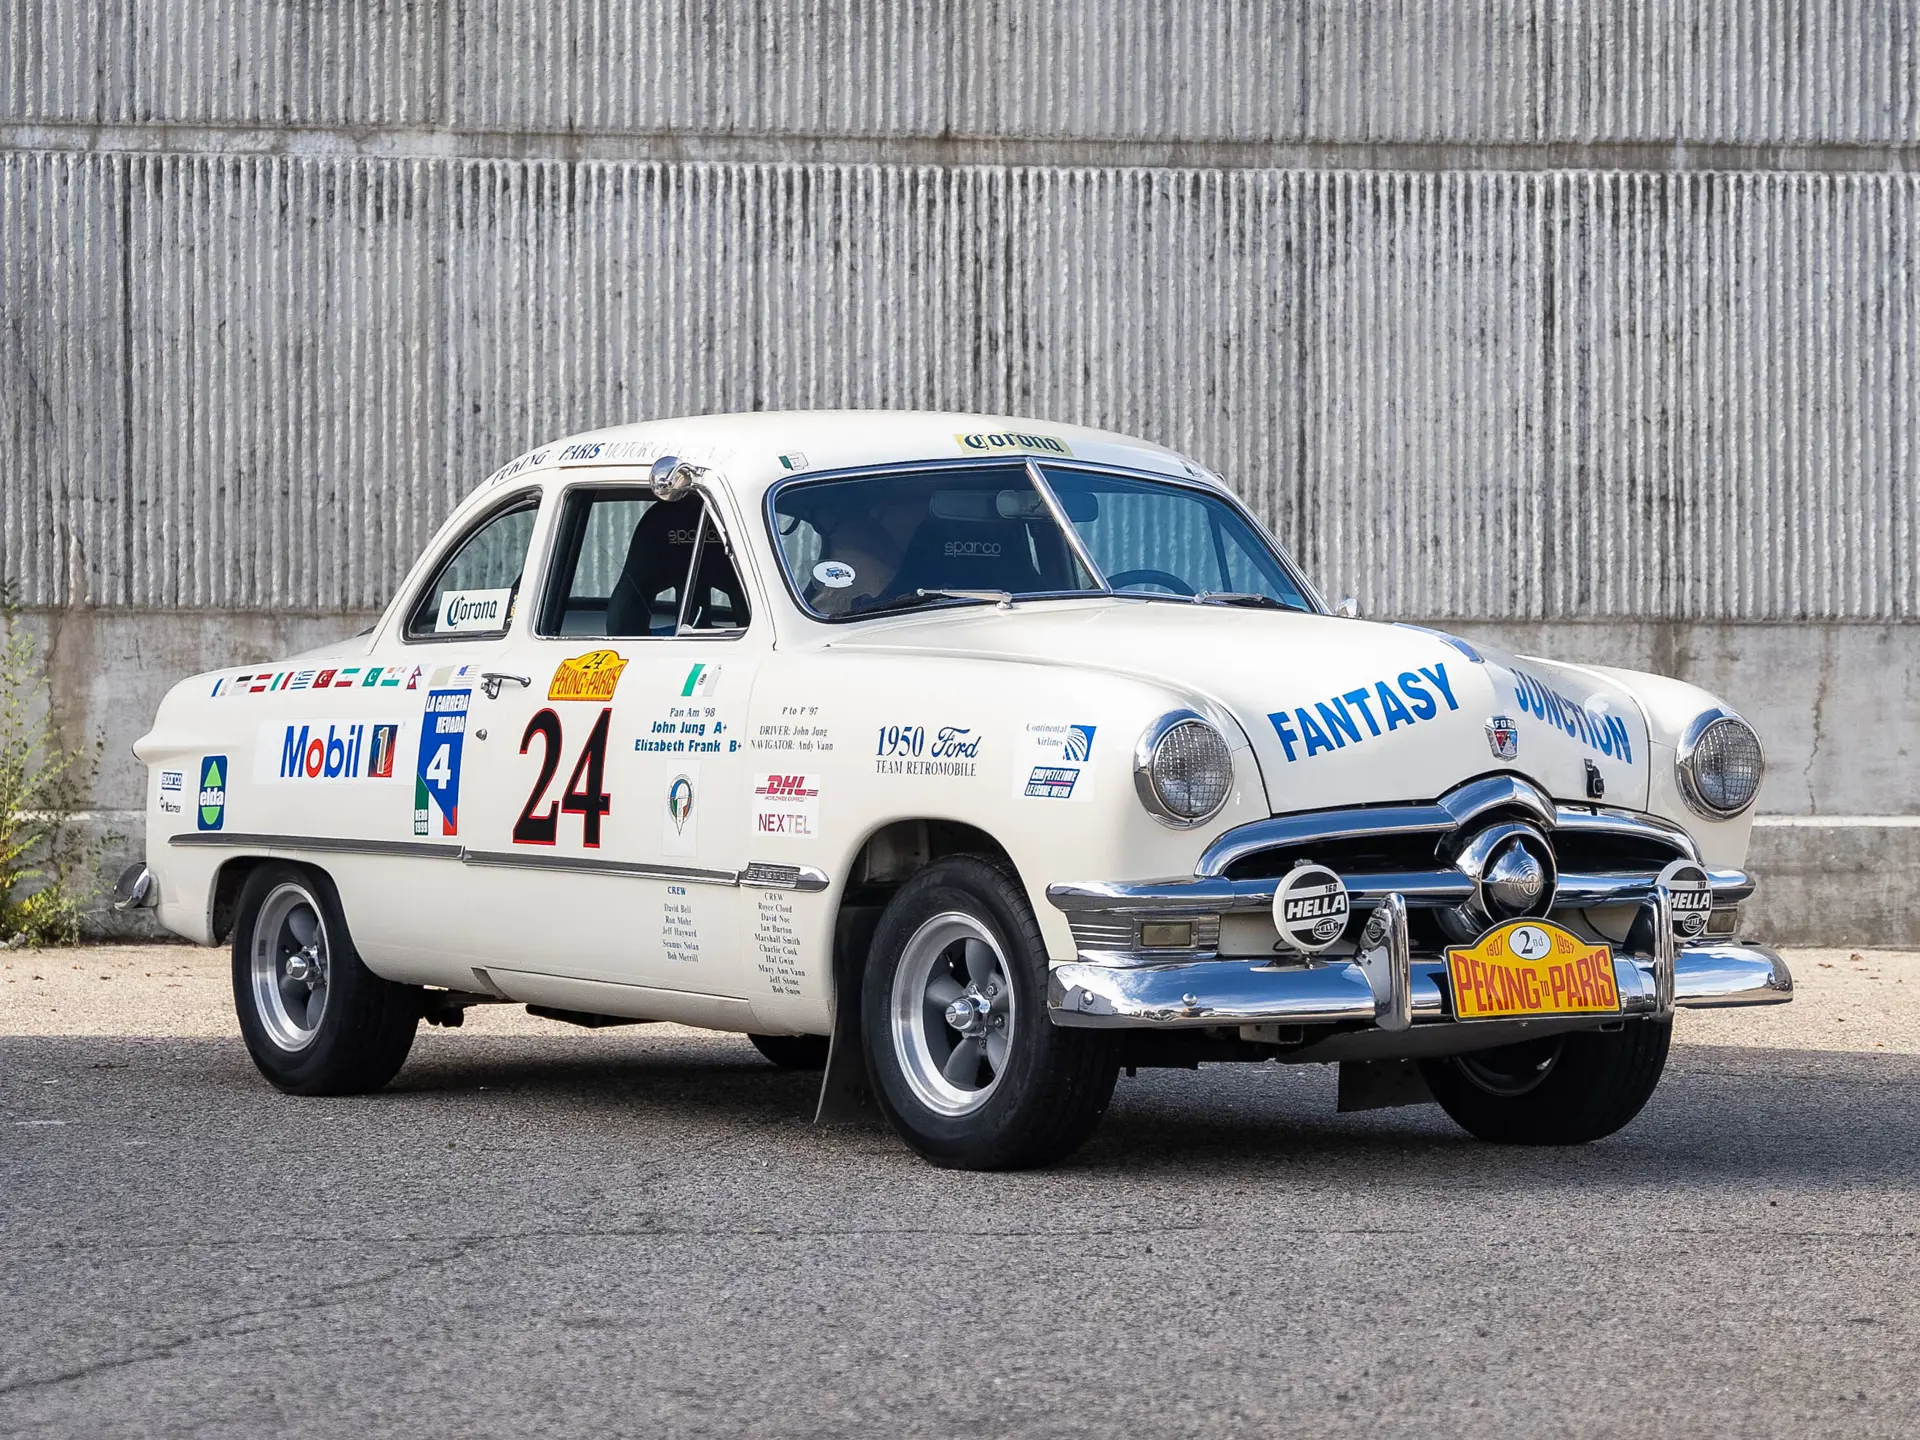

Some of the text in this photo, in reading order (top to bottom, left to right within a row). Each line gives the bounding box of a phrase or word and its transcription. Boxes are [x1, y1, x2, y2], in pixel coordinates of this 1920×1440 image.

[963, 432, 1065, 453] Corona
[558, 442, 606, 461] PARIS
[944, 540, 1001, 557] sparco
[446, 595, 498, 630] Corona
[581, 653, 610, 669] 24
[551, 663, 624, 694] PEKING PARIS
[425, 694, 469, 712] LA CARRERA
[782, 706, 788, 715] P
[789, 706, 797, 715] to
[800, 706, 806, 715] P
[669, 707, 684, 718] Pan
[686, 707, 700, 718] Am
[1267, 662, 1459, 763] FANTASY
[1509, 667, 1633, 765] JUNCTION
[435, 716, 466, 733] NEVADA
[651, 721, 727, 736] John Jung A+
[759, 725, 828, 737] DRIVER: John Jung
[1026, 723, 1068, 733] Continental
[634, 739, 742, 752] Elizabeth Frank B+
[751, 739, 795, 750] NAVIGATOR:
[799, 740, 813, 752] Andy
[876, 725, 982, 758] 1950 Ford
[1036, 737, 1063, 747] Airlines
[280, 724, 390, 778] Mobil 1
[426, 743, 452, 789] 4
[876, 760, 977, 776] TEAM RETROMOBILE
[512, 707, 613, 849] 24
[767, 775, 807, 795] DHL
[200, 787, 224, 806] elda
[758, 813, 812, 834] NEXTEL
[667, 886, 687, 895] CREW
[764, 892, 784, 901] CREW
[1325, 883, 1338, 893] 160
[664, 903, 679, 913] David
[758, 902, 793, 914] Royce Cloud
[1287, 894, 1346, 919] HELLA
[1670, 892, 1711, 909] HELLA
[761, 913, 777, 922] David
[754, 933, 801, 946] Marshall Smith
[1486, 930, 1575, 957] 1907 2nd 1997
[759, 944, 798, 956] Charlie Cook
[758, 964, 774, 975] Mary
[777, 966, 789, 975] Ann
[1452, 949, 1616, 1013] PEKING TO PARIS
